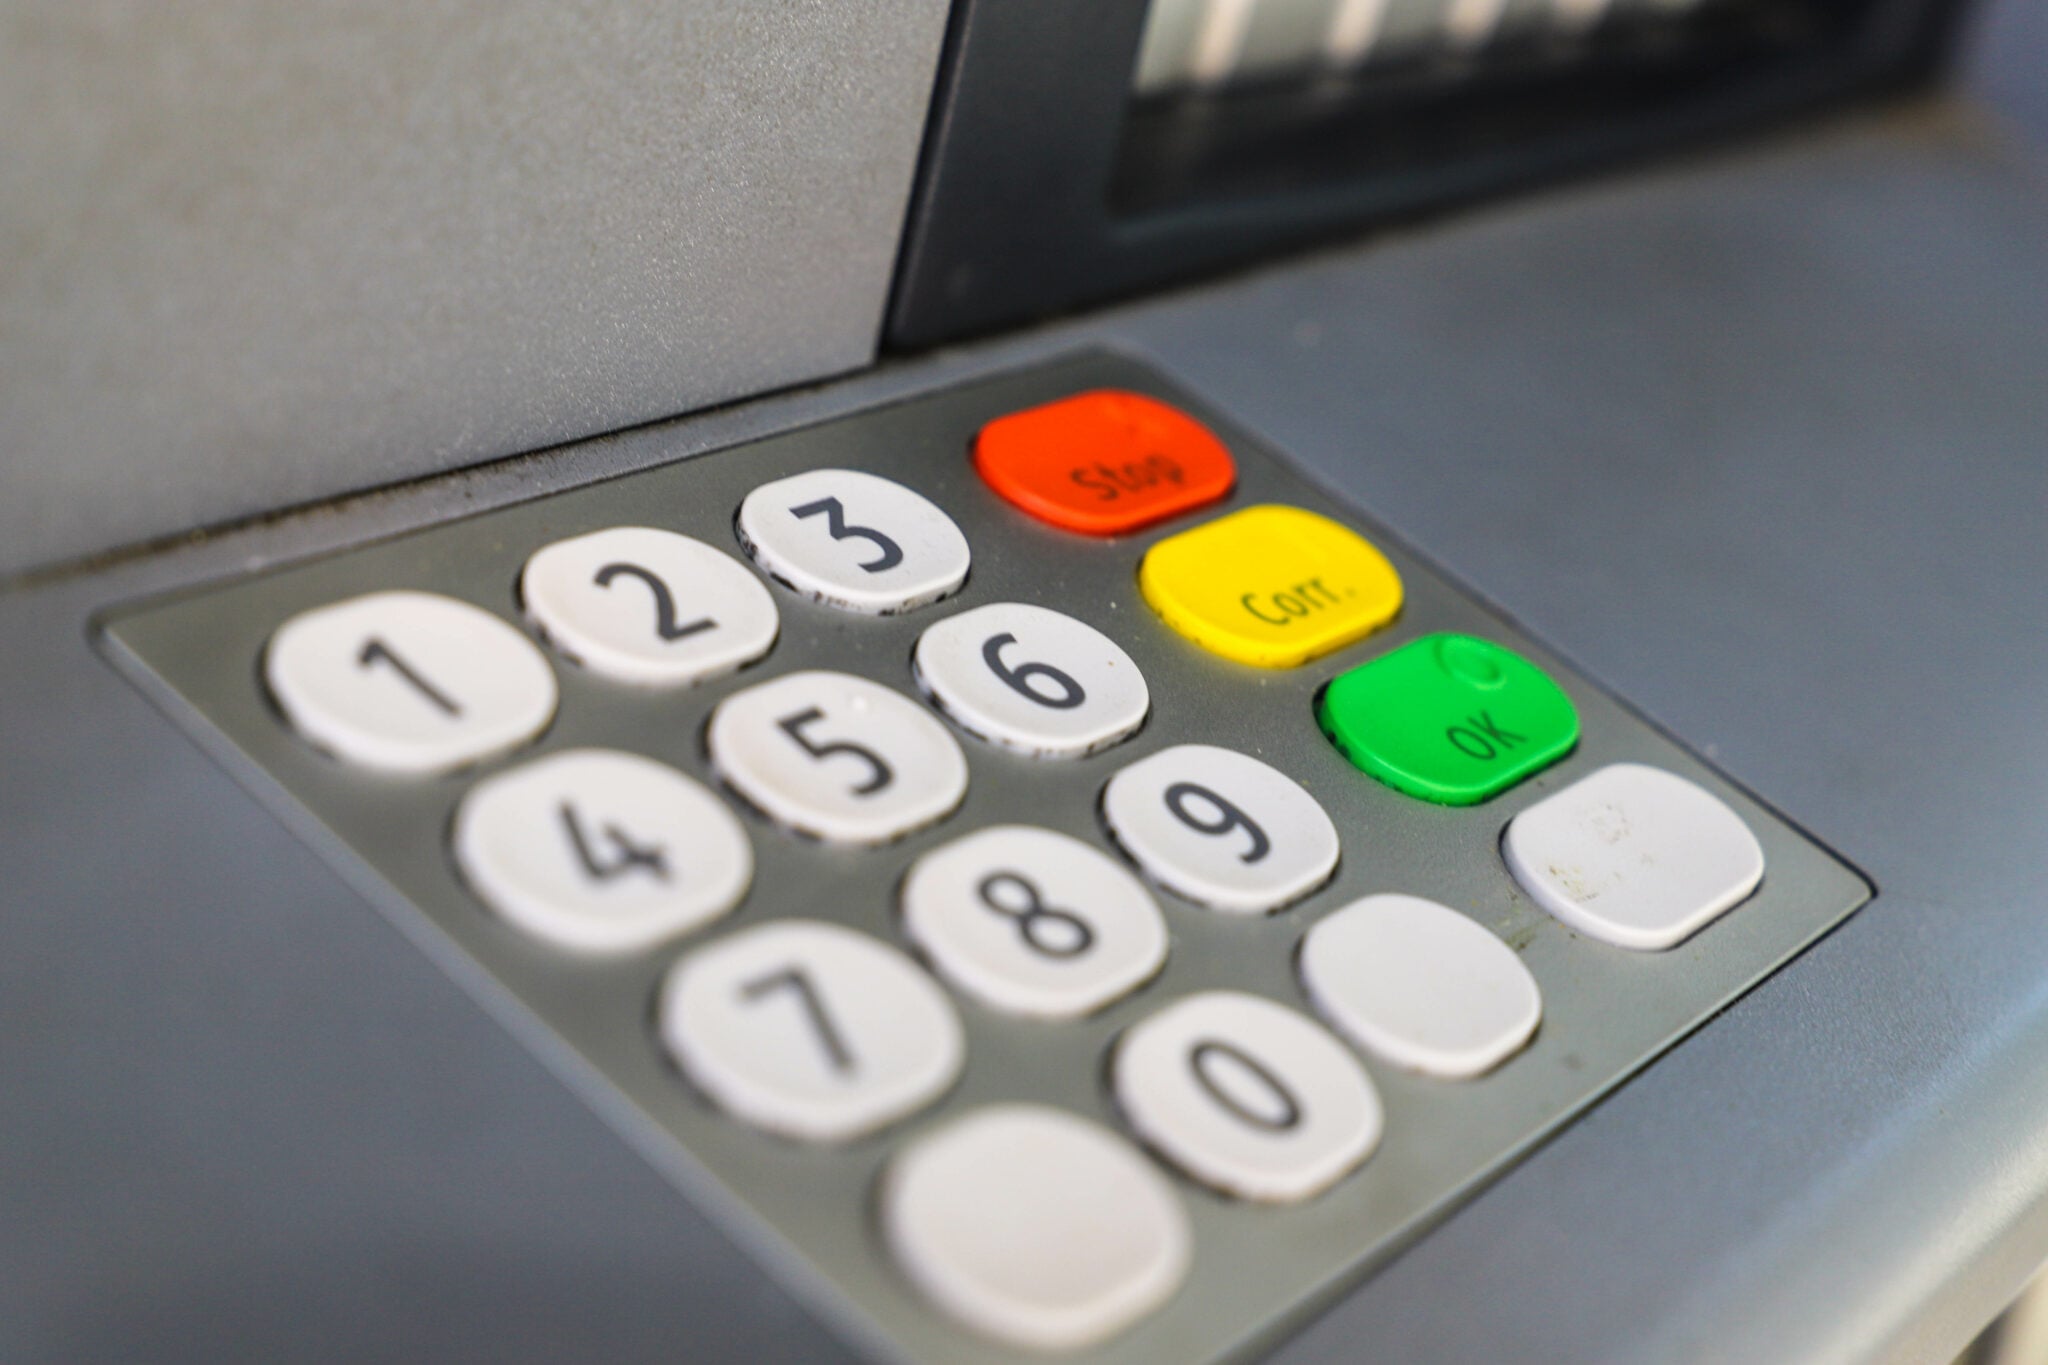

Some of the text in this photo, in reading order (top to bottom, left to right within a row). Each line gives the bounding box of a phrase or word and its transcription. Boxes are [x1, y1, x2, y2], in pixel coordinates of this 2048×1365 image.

[1070, 452, 1184, 504] Stop
[789, 496, 905, 573] 3
[594, 563, 717, 643] 2
[1241, 576, 1359, 627] Corr.
[356, 638, 461, 717] 1
[982, 632, 1087, 711] 6
[777, 708, 893, 797] 5
[1446, 709, 1527, 761] OK
[559, 804, 671, 884] 4
[1164, 782, 1270, 864] 9
[977, 871, 1097, 960] 8
[741, 967, 856, 1077] 7
[1187, 1039, 1305, 1135] 0
